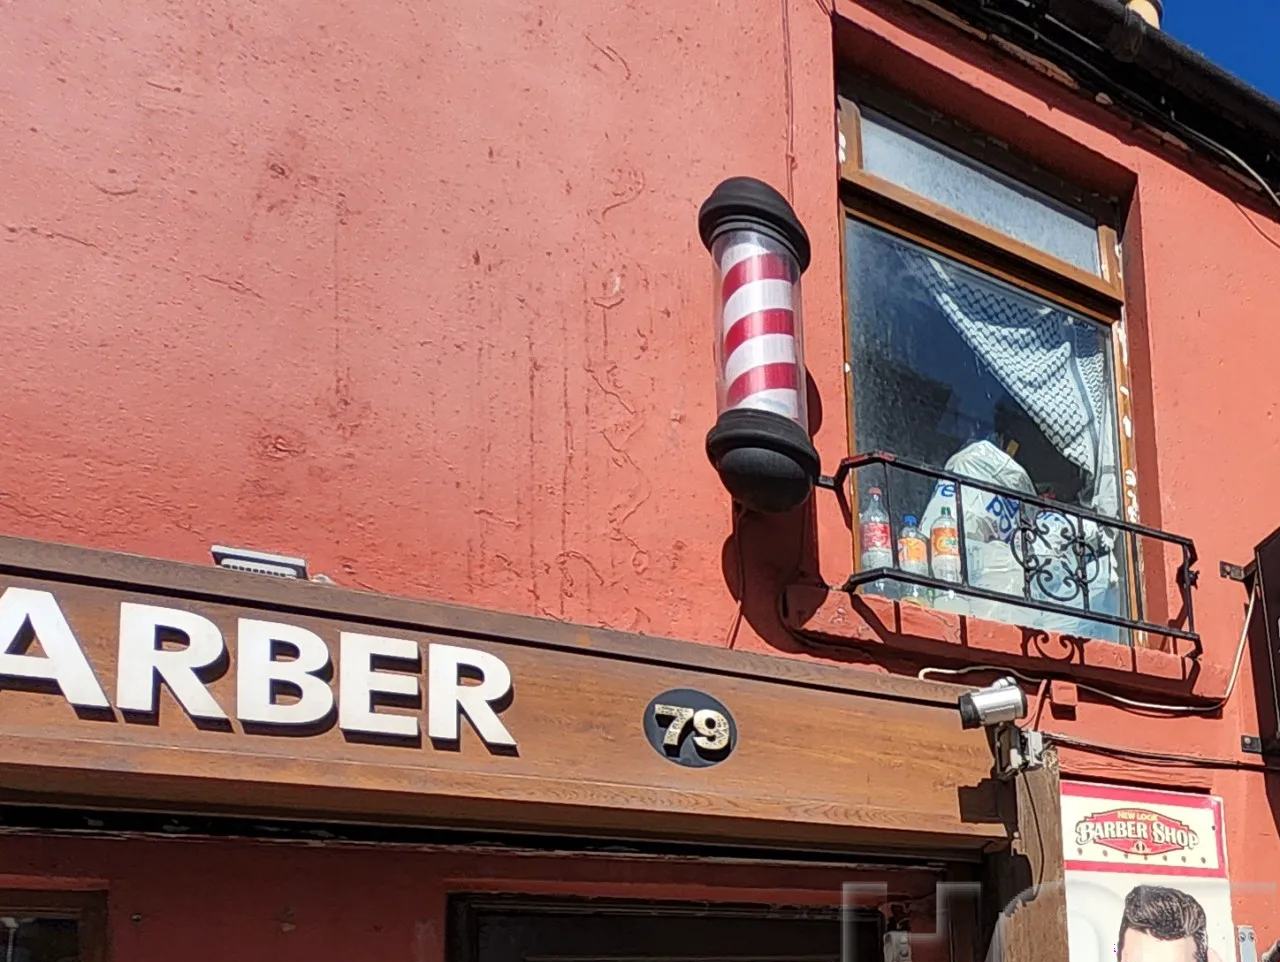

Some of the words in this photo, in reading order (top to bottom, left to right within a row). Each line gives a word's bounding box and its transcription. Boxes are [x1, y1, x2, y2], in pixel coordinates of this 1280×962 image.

[0, 586, 518, 746] ARBER
[655, 704, 730, 750] 79
[1117, 811, 1135, 821] NEW
[1075, 821, 1148, 845] BARBER
[1151, 821, 1199, 850] SHOP
